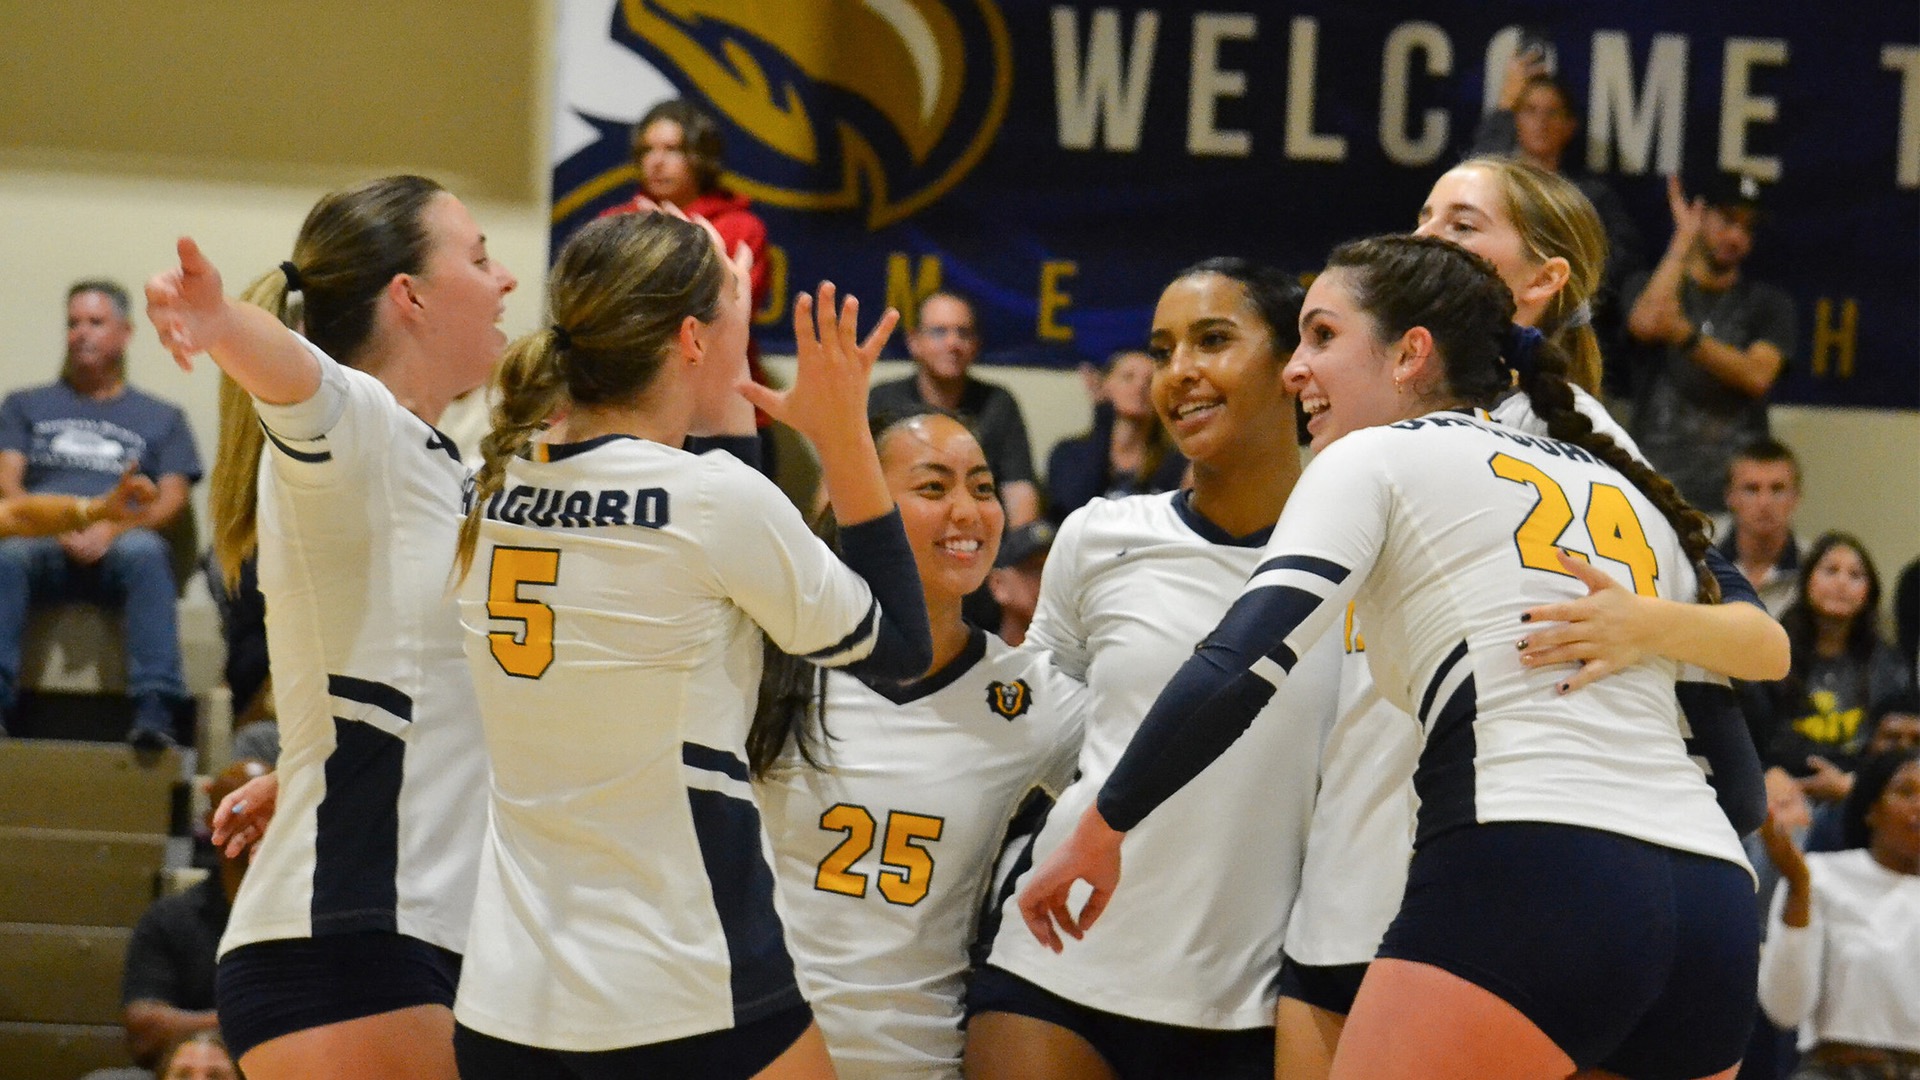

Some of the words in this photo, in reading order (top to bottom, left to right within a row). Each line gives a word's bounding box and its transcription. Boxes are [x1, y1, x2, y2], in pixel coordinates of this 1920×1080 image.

[1487, 451, 1659, 599] 24
[486, 545, 562, 680] 5
[814, 803, 944, 907] 25
